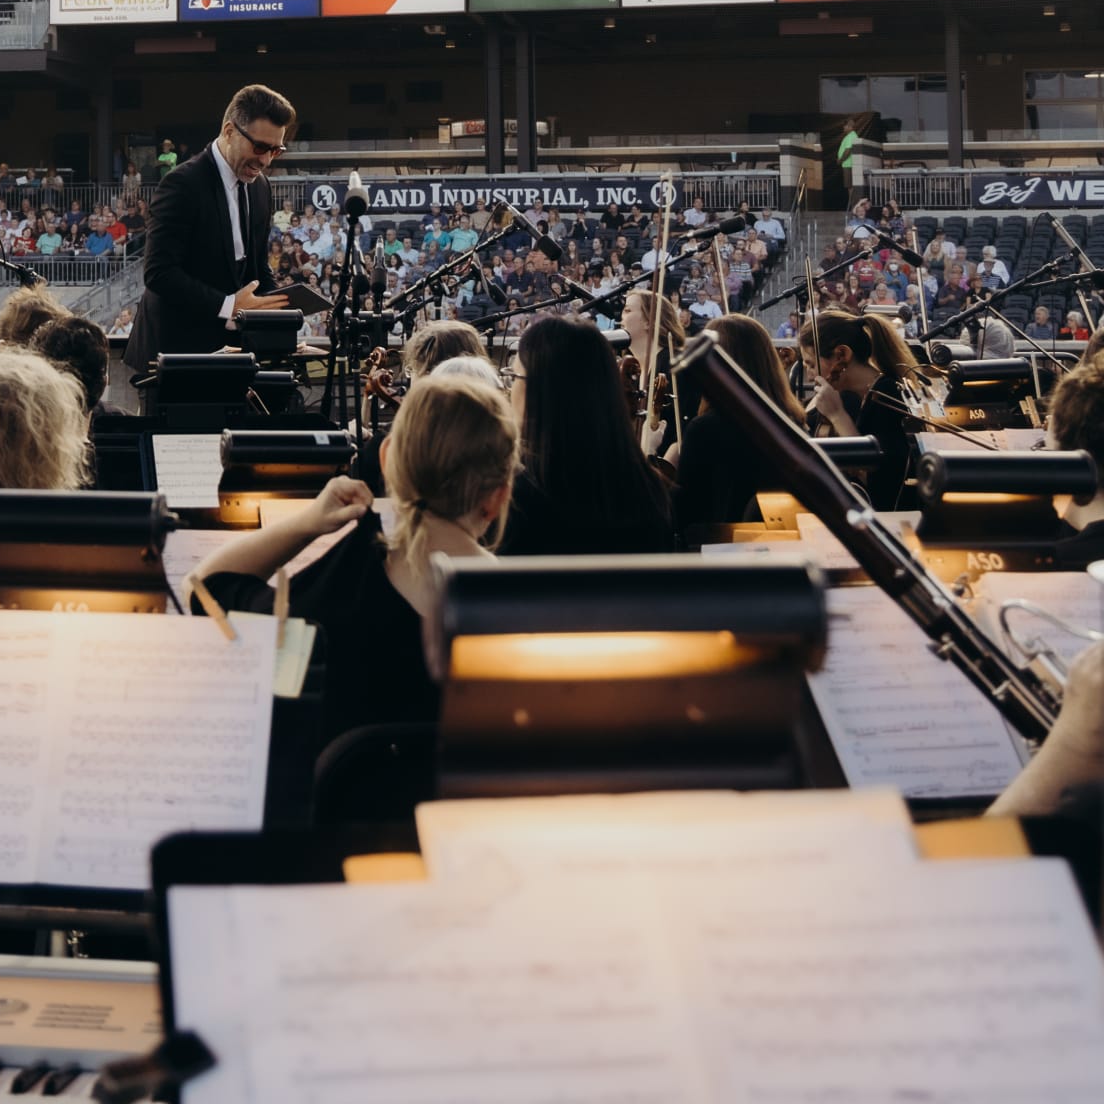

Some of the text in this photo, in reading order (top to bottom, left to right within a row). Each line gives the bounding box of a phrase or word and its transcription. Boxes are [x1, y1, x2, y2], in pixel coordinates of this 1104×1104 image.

[229, 2, 284, 12] INSURANCE
[347, 183, 643, 209] AND INDUSTRIAL, INC.
[978, 177, 1042, 205] B&J
[969, 409, 985, 420] ASO
[967, 551, 1004, 571] ASO
